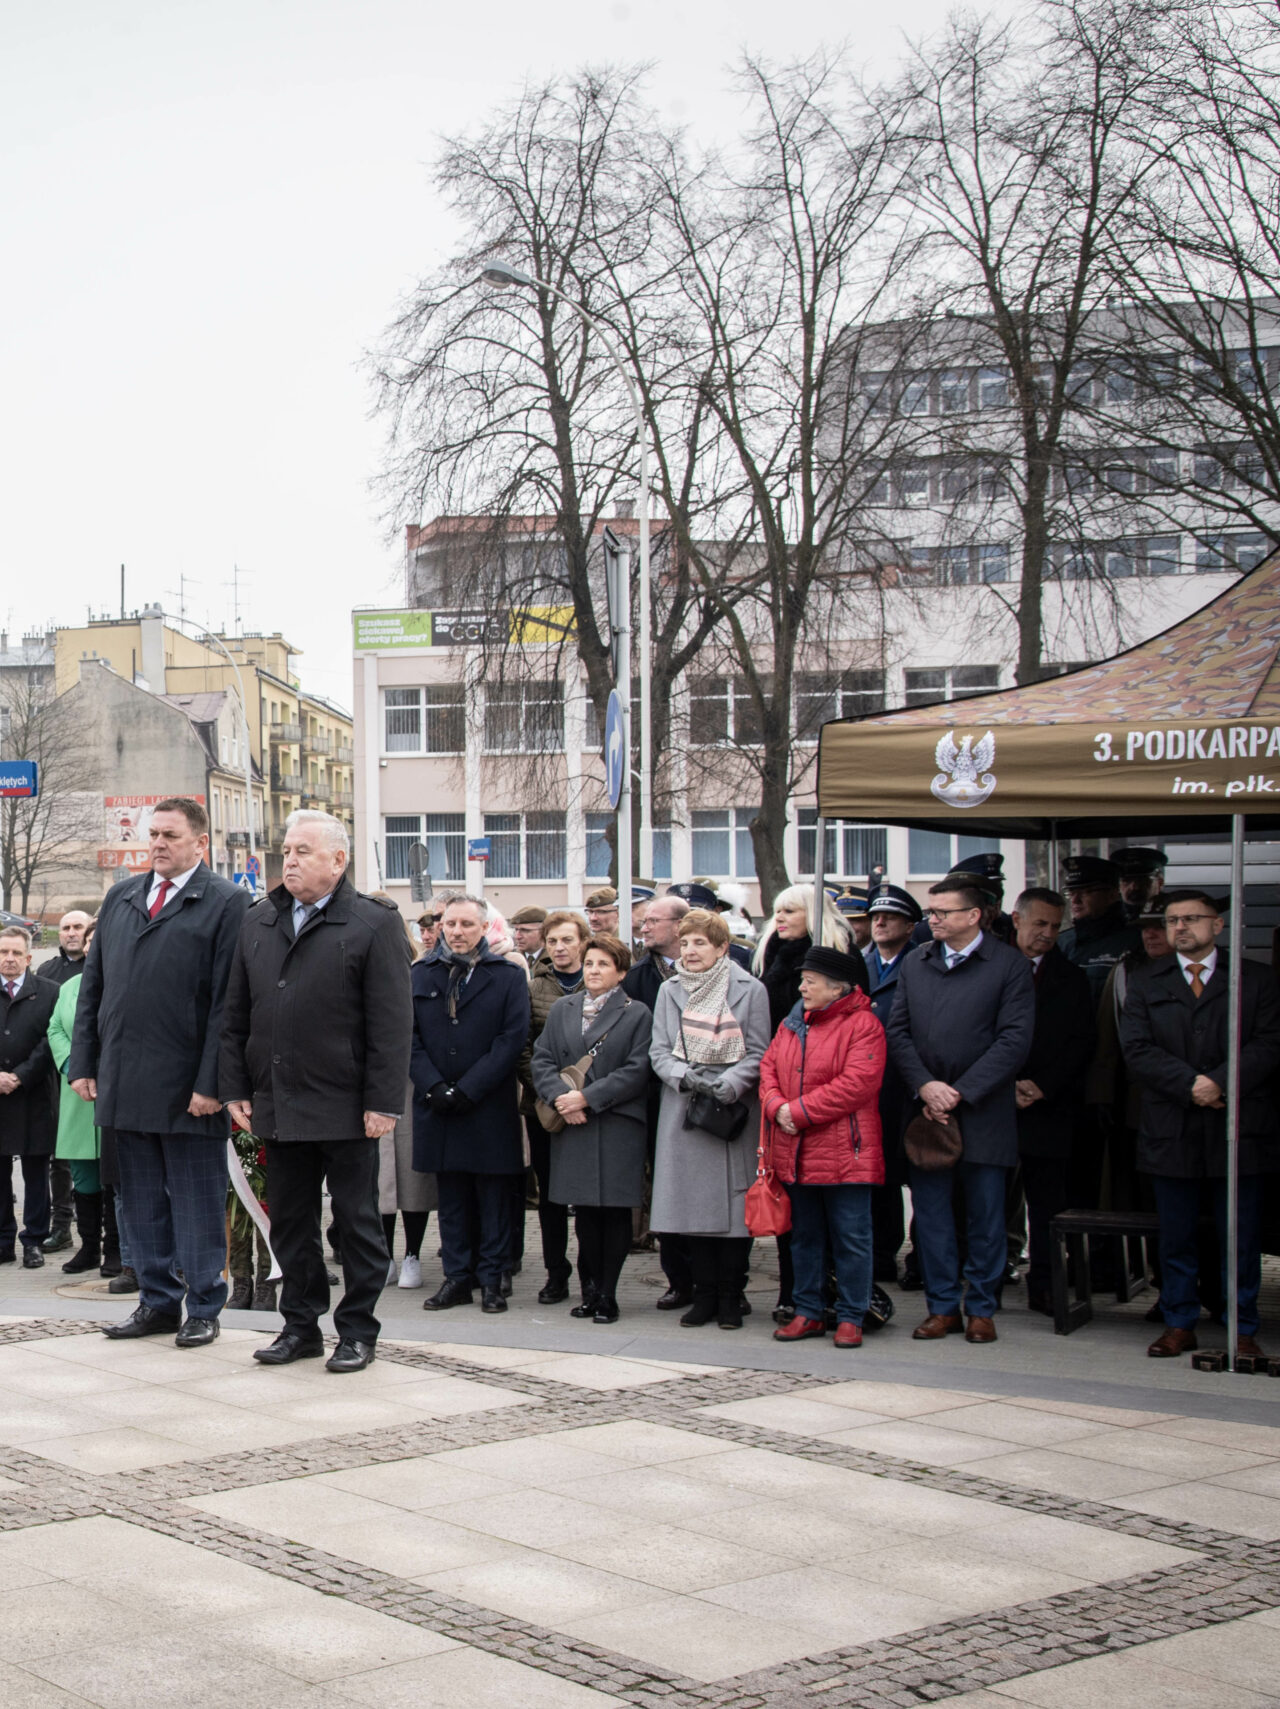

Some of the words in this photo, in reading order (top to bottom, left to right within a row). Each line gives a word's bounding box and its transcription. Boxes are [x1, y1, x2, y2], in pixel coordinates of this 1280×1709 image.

[435, 624, 449, 633] do
[1093, 733, 1120, 762] 3.
[1125, 726, 1280, 760] PODKARPA
[1172, 776, 1215, 795] im.
[1224, 775, 1280, 798] płk.
